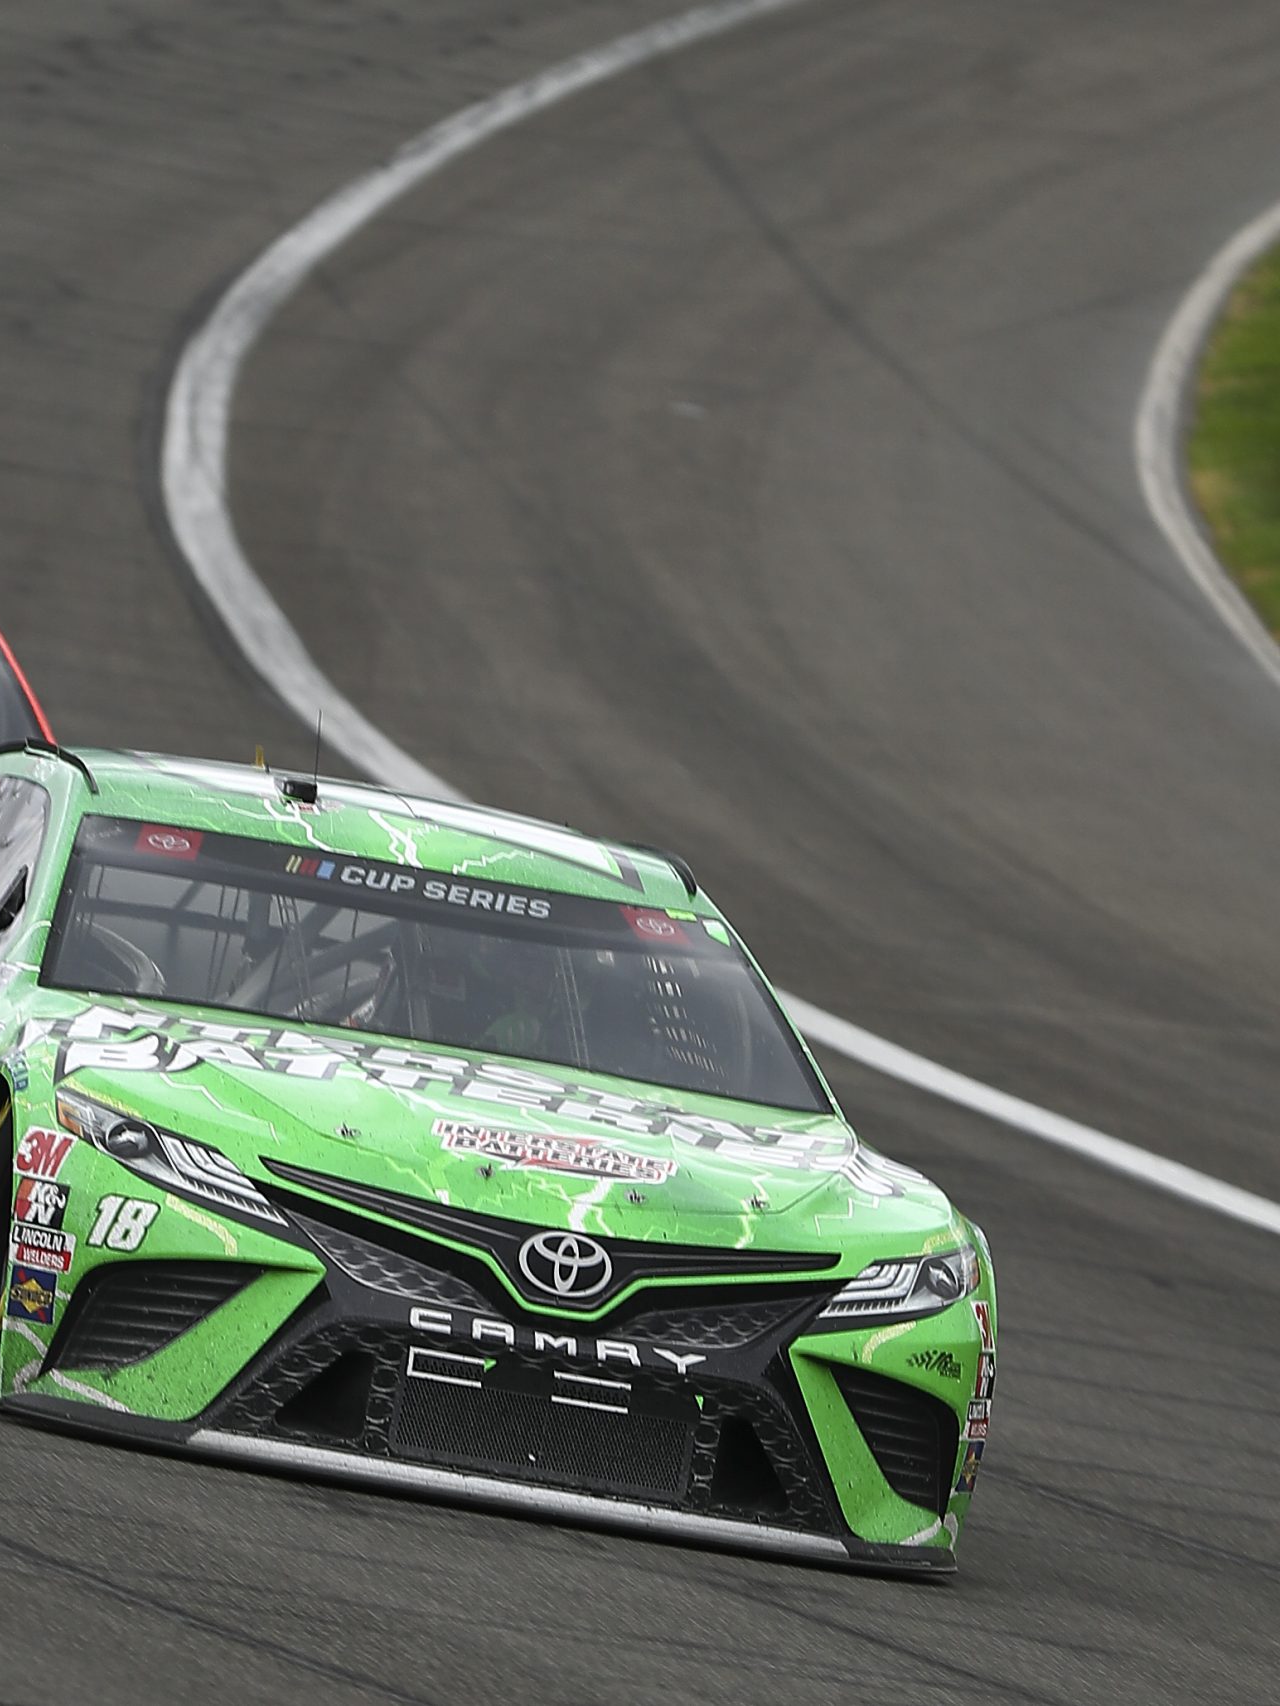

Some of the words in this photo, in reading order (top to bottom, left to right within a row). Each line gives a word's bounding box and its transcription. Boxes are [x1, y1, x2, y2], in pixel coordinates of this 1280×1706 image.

[340, 865, 416, 893] CUP
[422, 881, 552, 919] SERIES
[17, 1130, 75, 1178] 3M
[436, 1120, 677, 1175] INTERSTATE
[446, 1133, 664, 1181] BATTERIES
[13, 1225, 64, 1252] LINCOLN
[86, 1193, 162, 1253] 18
[23, 1246, 65, 1268] WELDERS
[409, 1306, 707, 1375] CAMRY
